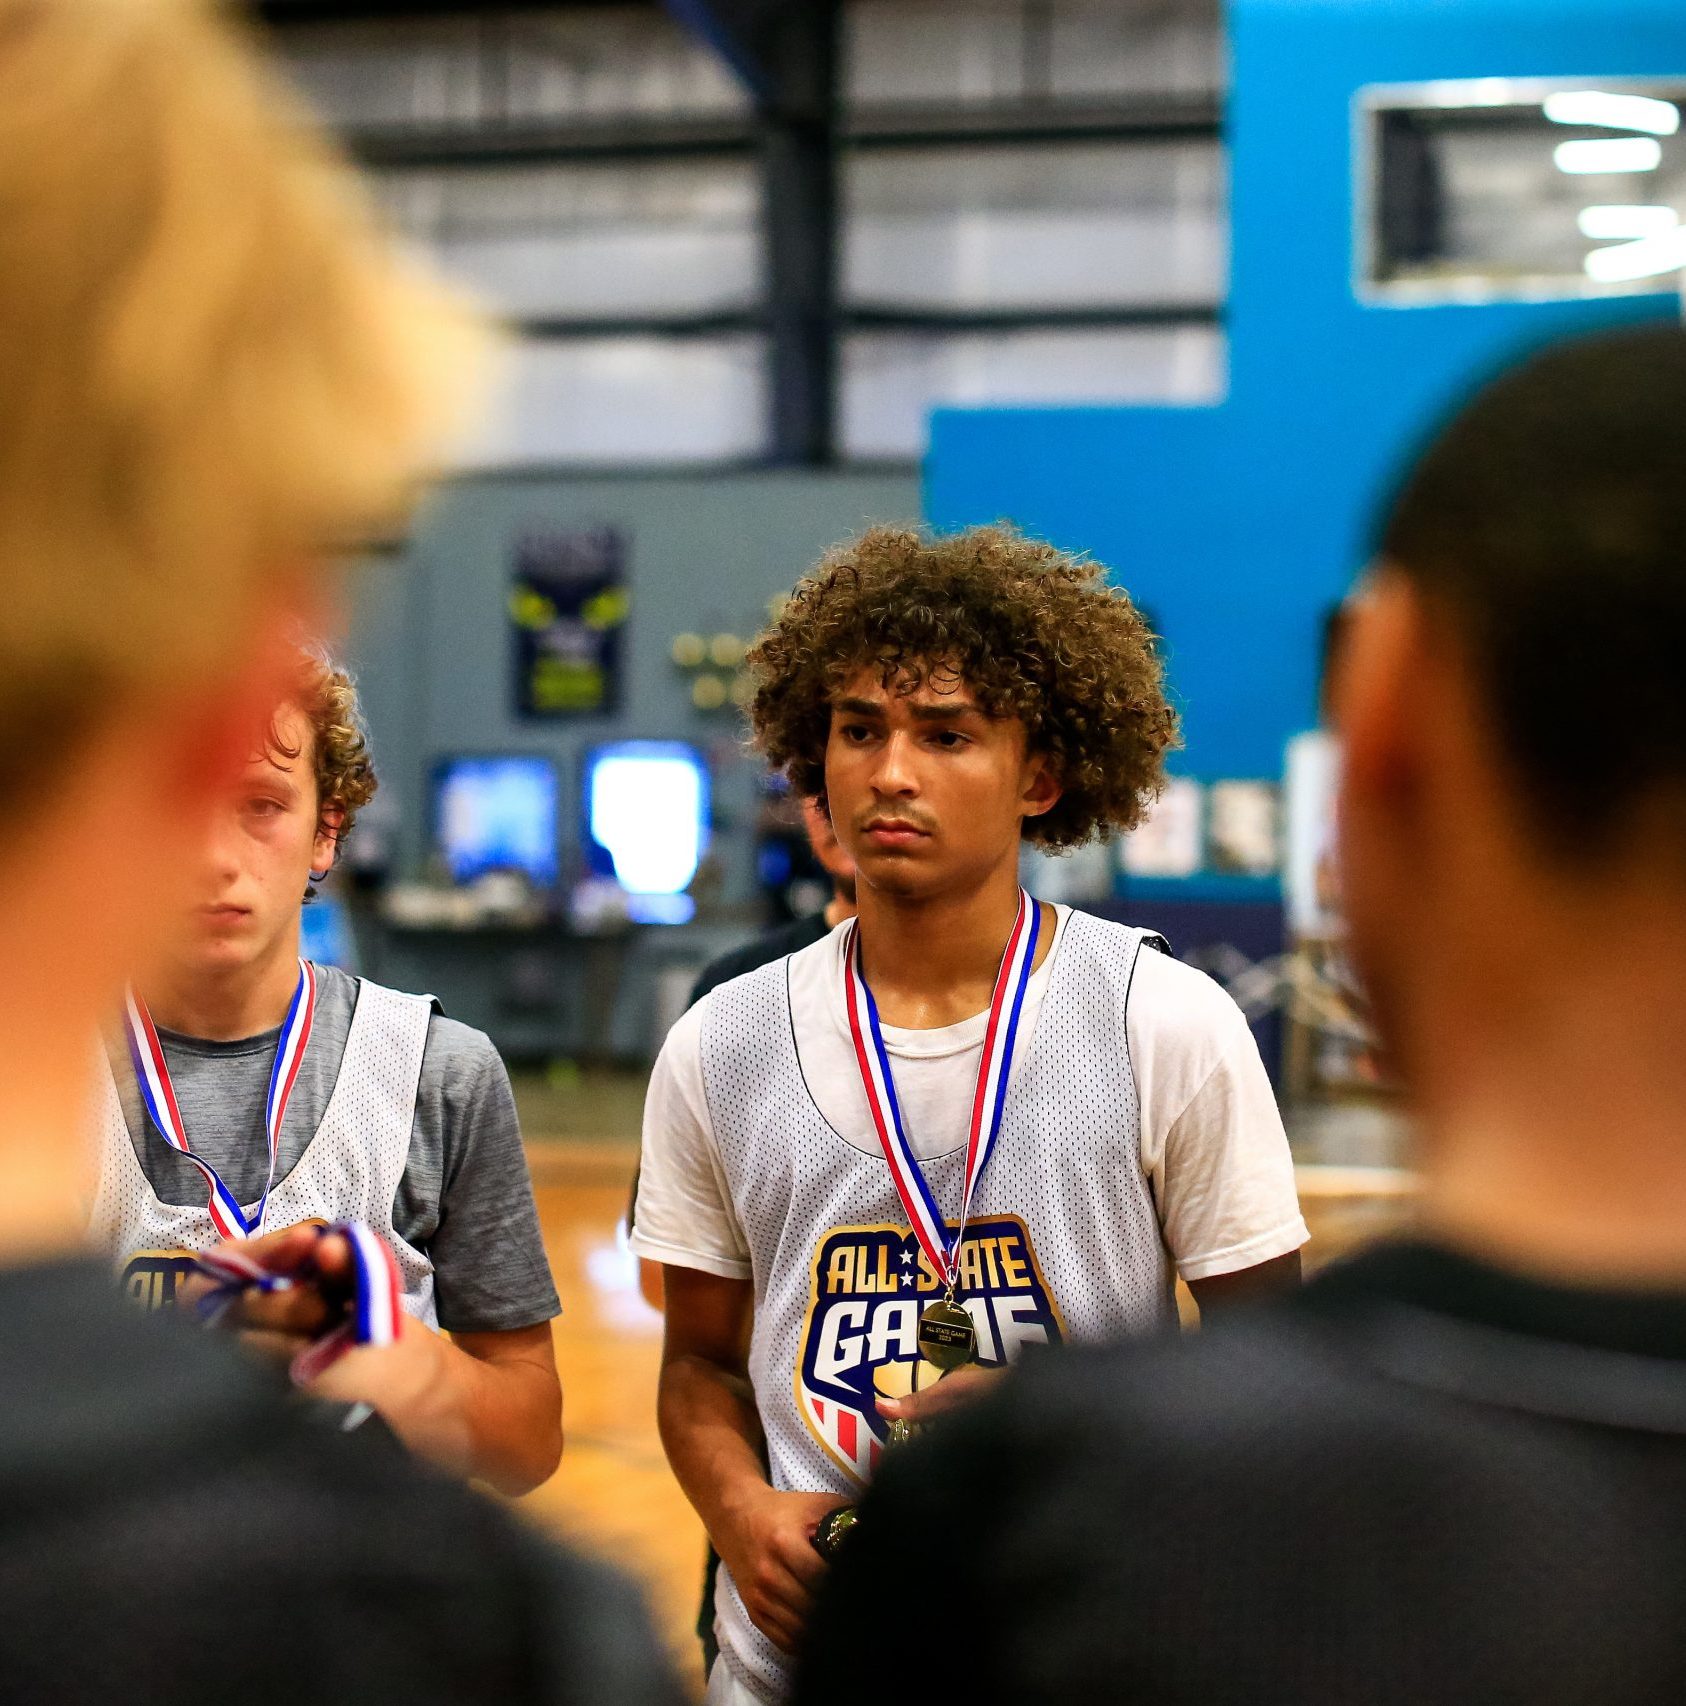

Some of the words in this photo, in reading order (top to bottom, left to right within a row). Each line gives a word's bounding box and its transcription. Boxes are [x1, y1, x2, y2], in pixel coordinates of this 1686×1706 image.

[827, 1244, 898, 1294] ALL
[917, 1237, 1032, 1292] SATE
[951, 1330, 966, 1338] GAME
